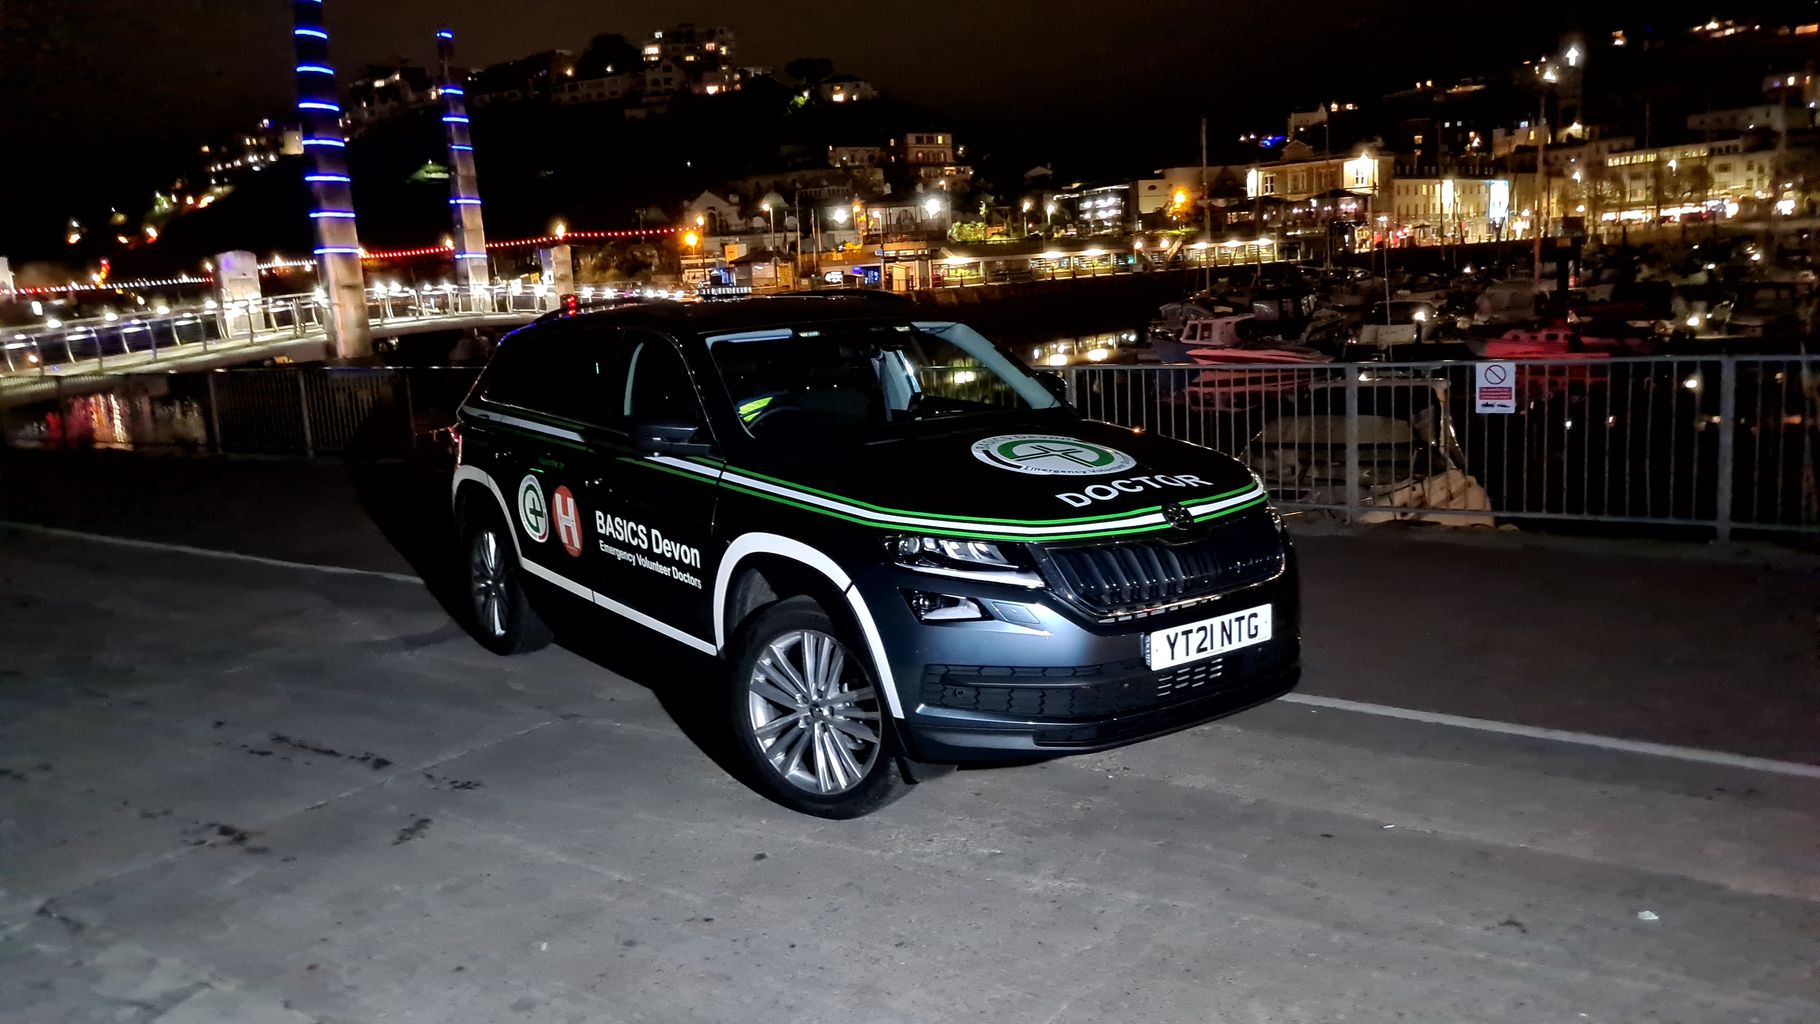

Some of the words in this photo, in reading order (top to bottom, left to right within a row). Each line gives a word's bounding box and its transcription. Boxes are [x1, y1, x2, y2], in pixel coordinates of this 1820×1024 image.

[1055, 474, 1214, 507] DOCTOR
[555, 493, 581, 549] H
[595, 510, 648, 549] BASICS
[651, 529, 701, 568] Devon
[599, 540, 636, 566] Emergency
[636, 554, 671, 577] Volunteer
[672, 566, 702, 590] Doctors
[1166, 624, 1214, 660] YT21
[1221, 613, 1258, 647] NTG
